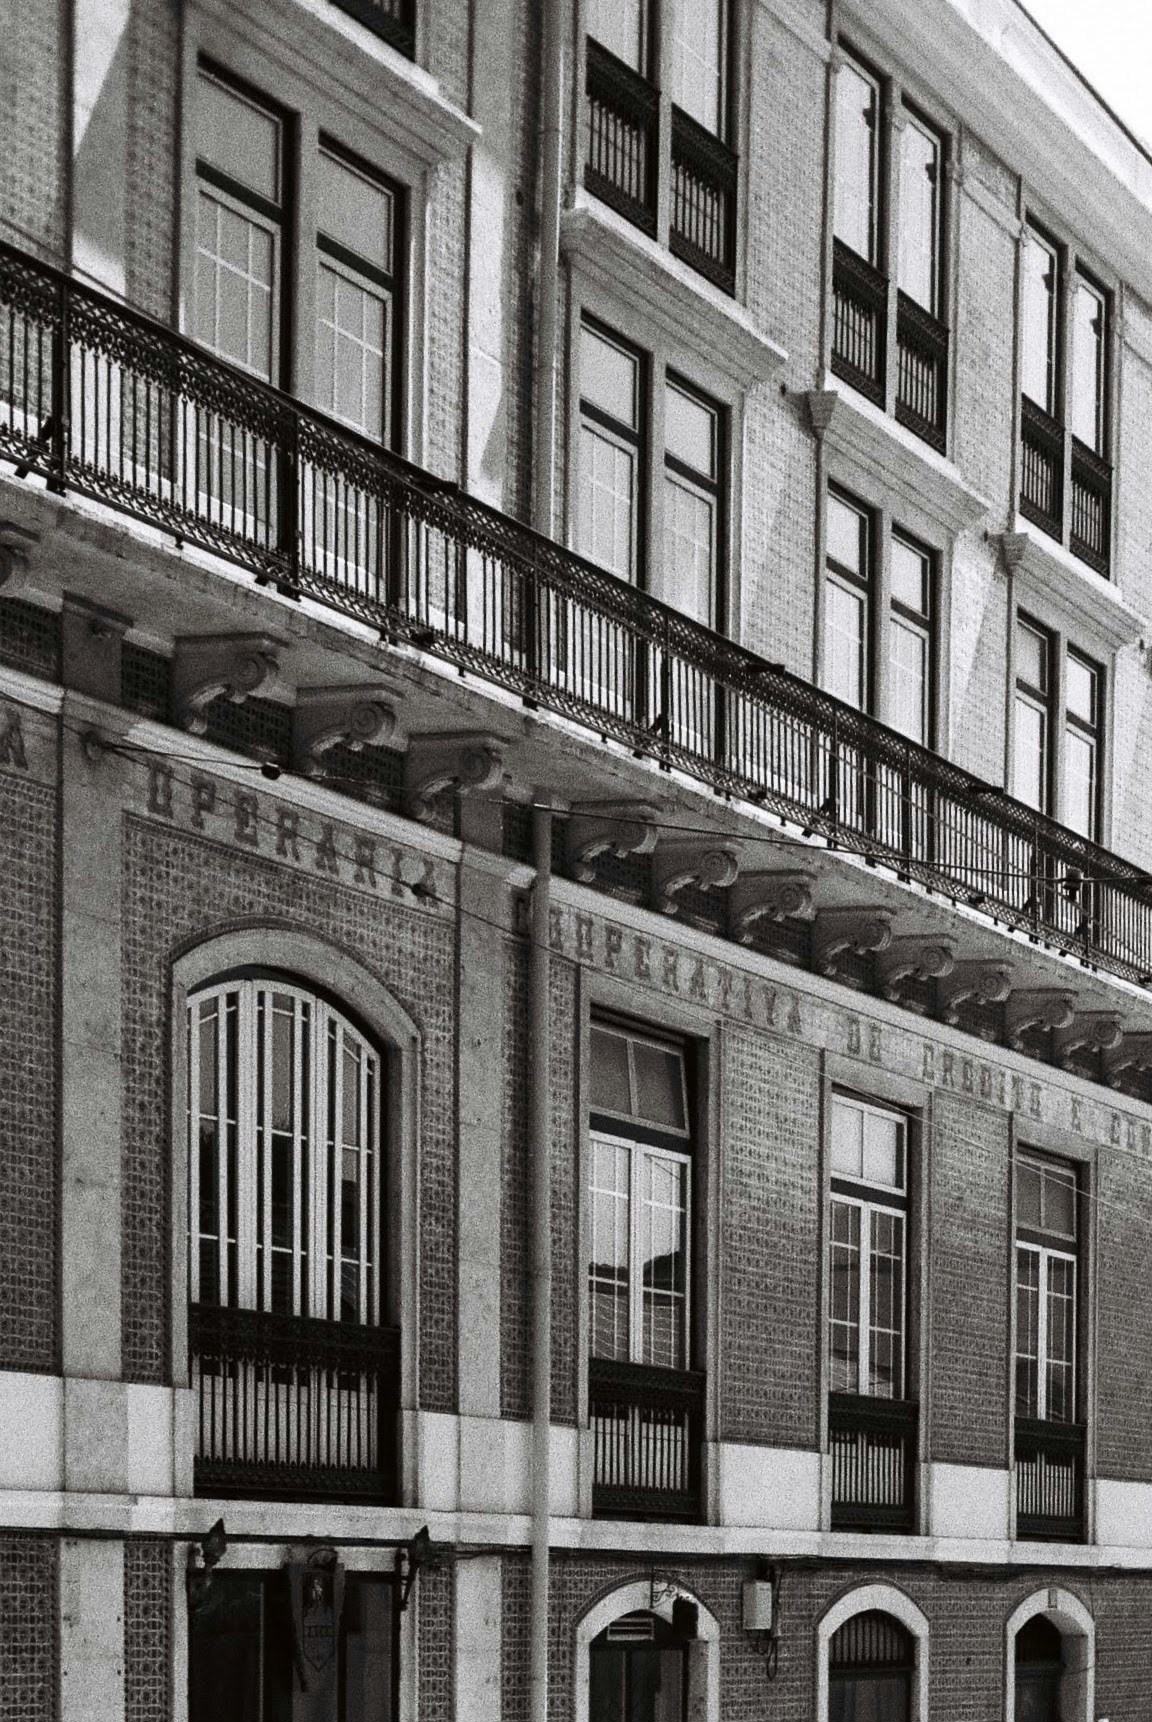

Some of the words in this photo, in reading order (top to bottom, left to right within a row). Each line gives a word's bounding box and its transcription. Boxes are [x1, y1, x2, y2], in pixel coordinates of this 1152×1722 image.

[147, 759, 440, 910] OPERARIA
[846, 1015, 882, 1063] DE
[922, 1042, 1042, 1117] CREDITO
